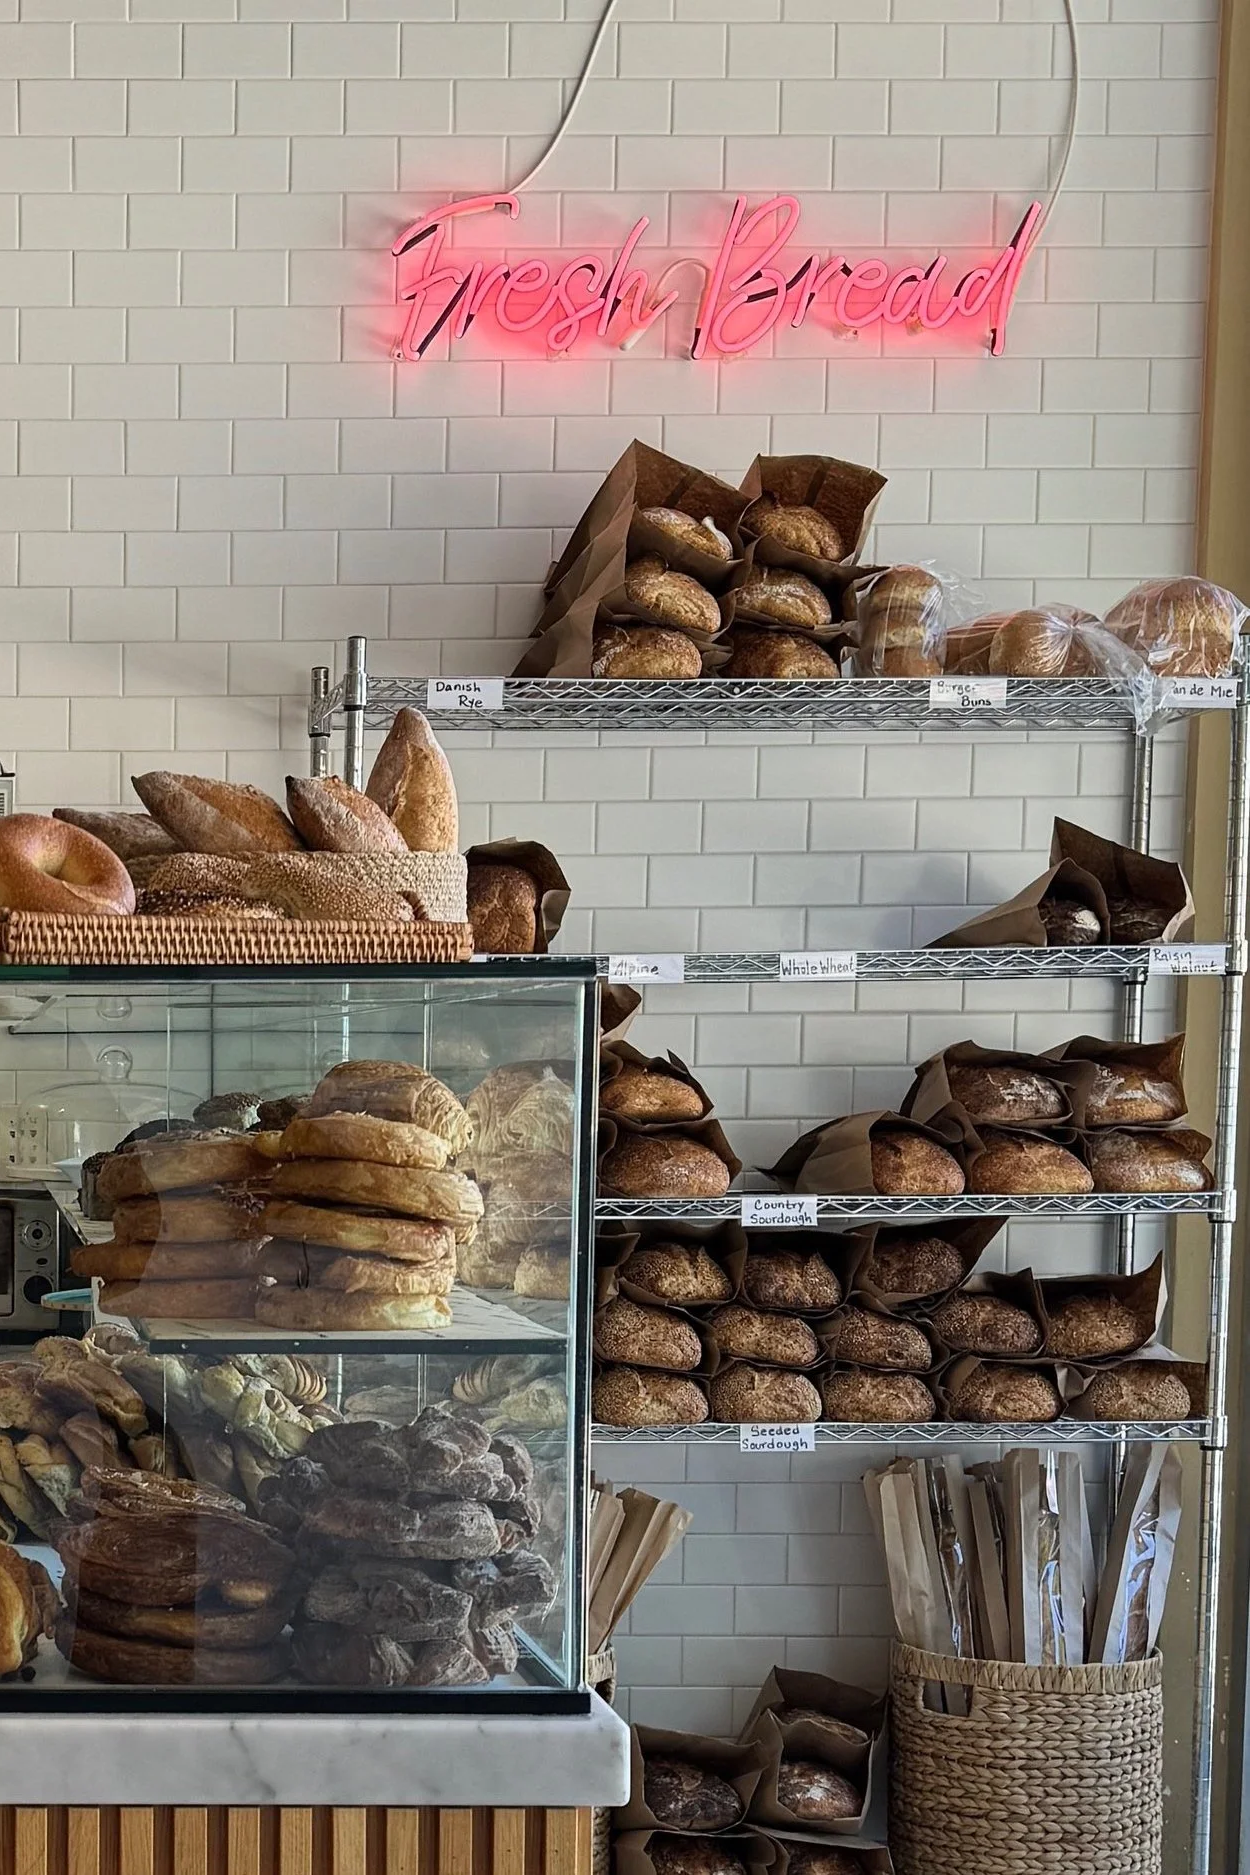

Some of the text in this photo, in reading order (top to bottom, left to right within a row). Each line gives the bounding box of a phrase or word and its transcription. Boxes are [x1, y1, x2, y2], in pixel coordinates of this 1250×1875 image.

[392, 193, 1041, 361] Fresh Bread
[435, 681, 481, 692] Danish
[1190, 684, 1204, 696] de
[458, 694, 484, 708] Rye
[961, 695, 992, 707] Buns
[781, 956, 854, 976] Whole Wheat
[754, 1199, 805, 1213] Country
[750, 1212, 812, 1226] Sourdough
[750, 1424, 800, 1437] Seeded
[742, 1438, 808, 1451] Sourdough
